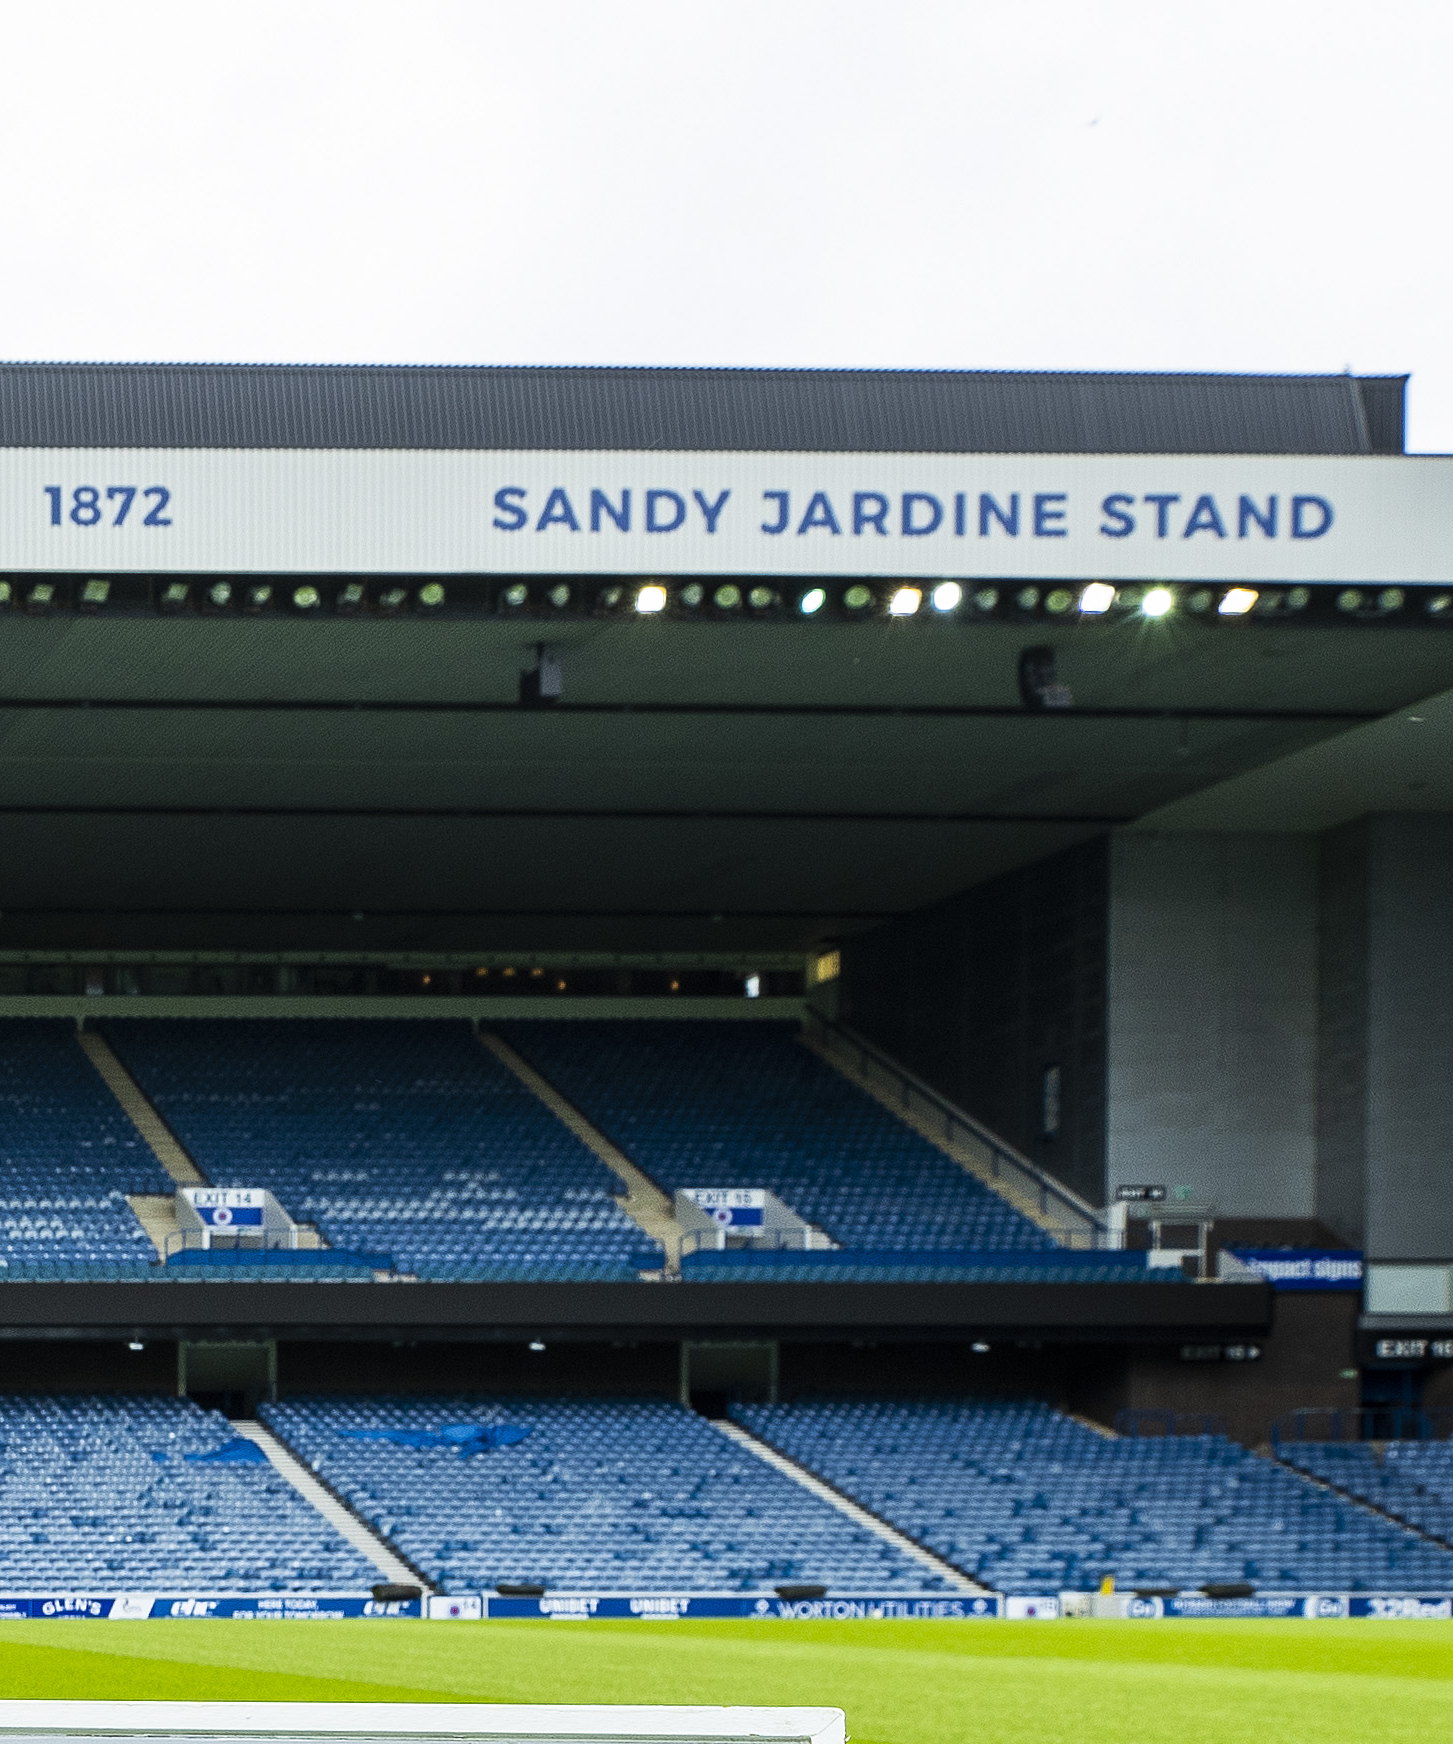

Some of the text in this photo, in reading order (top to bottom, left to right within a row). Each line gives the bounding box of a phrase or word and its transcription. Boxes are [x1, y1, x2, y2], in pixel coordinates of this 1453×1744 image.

[44, 485, 172, 527] 1872
[492, 486, 1335, 539] SANDY JARDINE STAND
[194, 1192, 252, 1204] EXIT 14
[695, 1192, 728, 1204] EXIT
[1376, 1340, 1428, 1358] EXIT
[42, 1598, 102, 1616] GLEN'S
[629, 1599, 691, 1613] UNIBET
[777, 1600, 964, 1618] WORTON UTILITIES
[1369, 1598, 1452, 1619] 32Red
